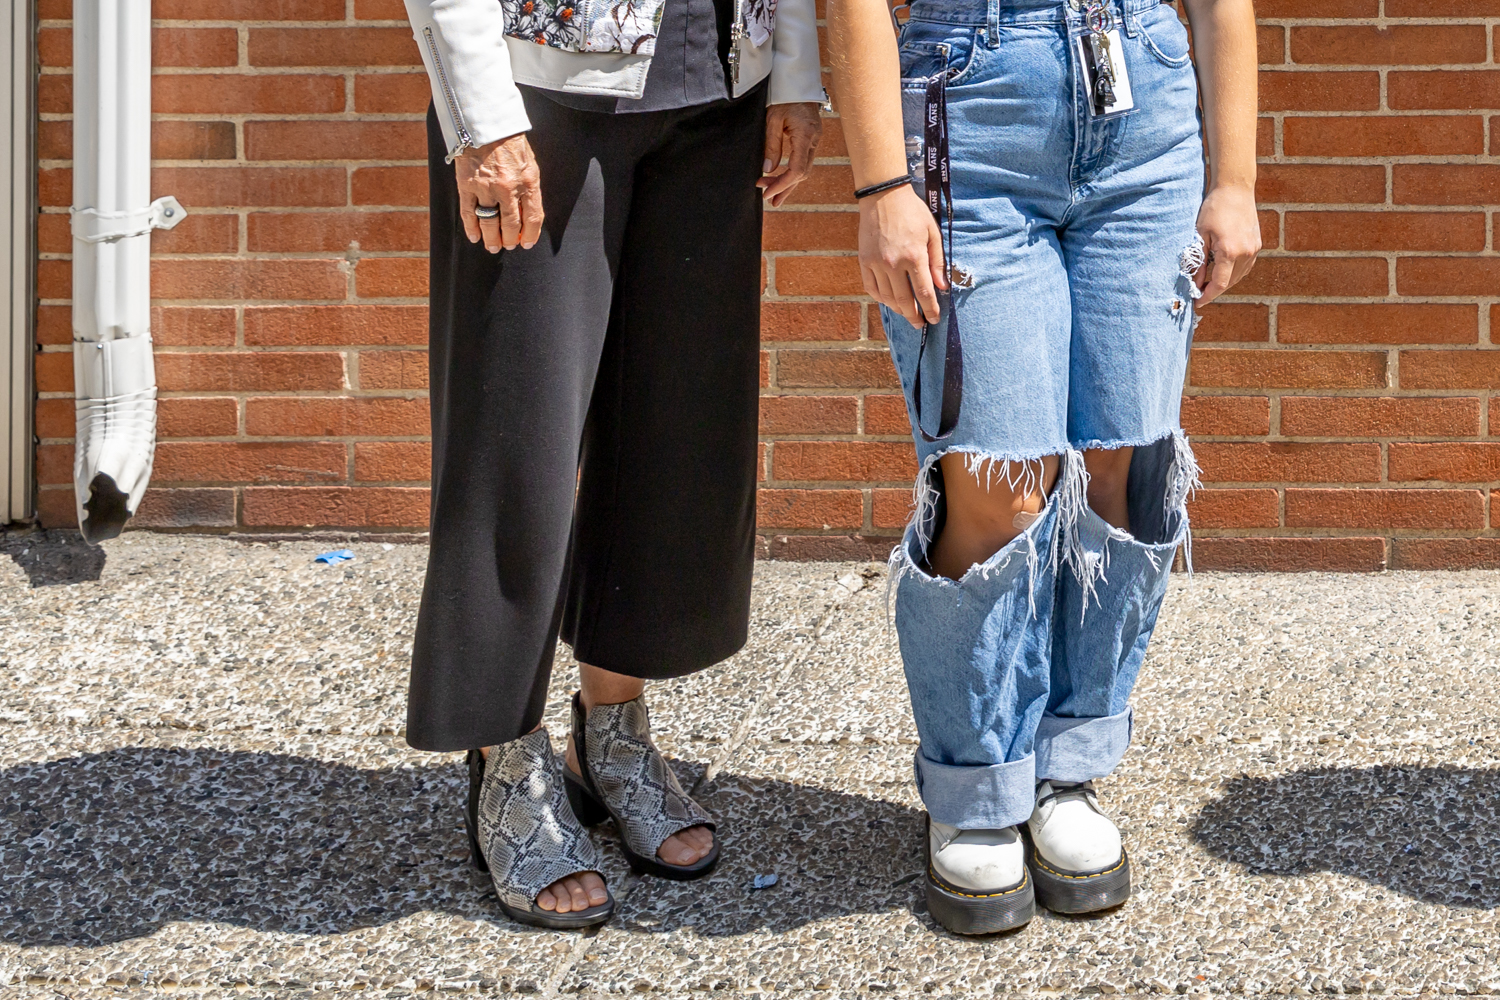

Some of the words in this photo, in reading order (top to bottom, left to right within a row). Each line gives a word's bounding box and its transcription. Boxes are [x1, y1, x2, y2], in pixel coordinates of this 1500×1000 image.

[928, 102, 938, 128] VANS
[928, 146, 938, 172] VANS
[929, 189, 938, 214] VANS
